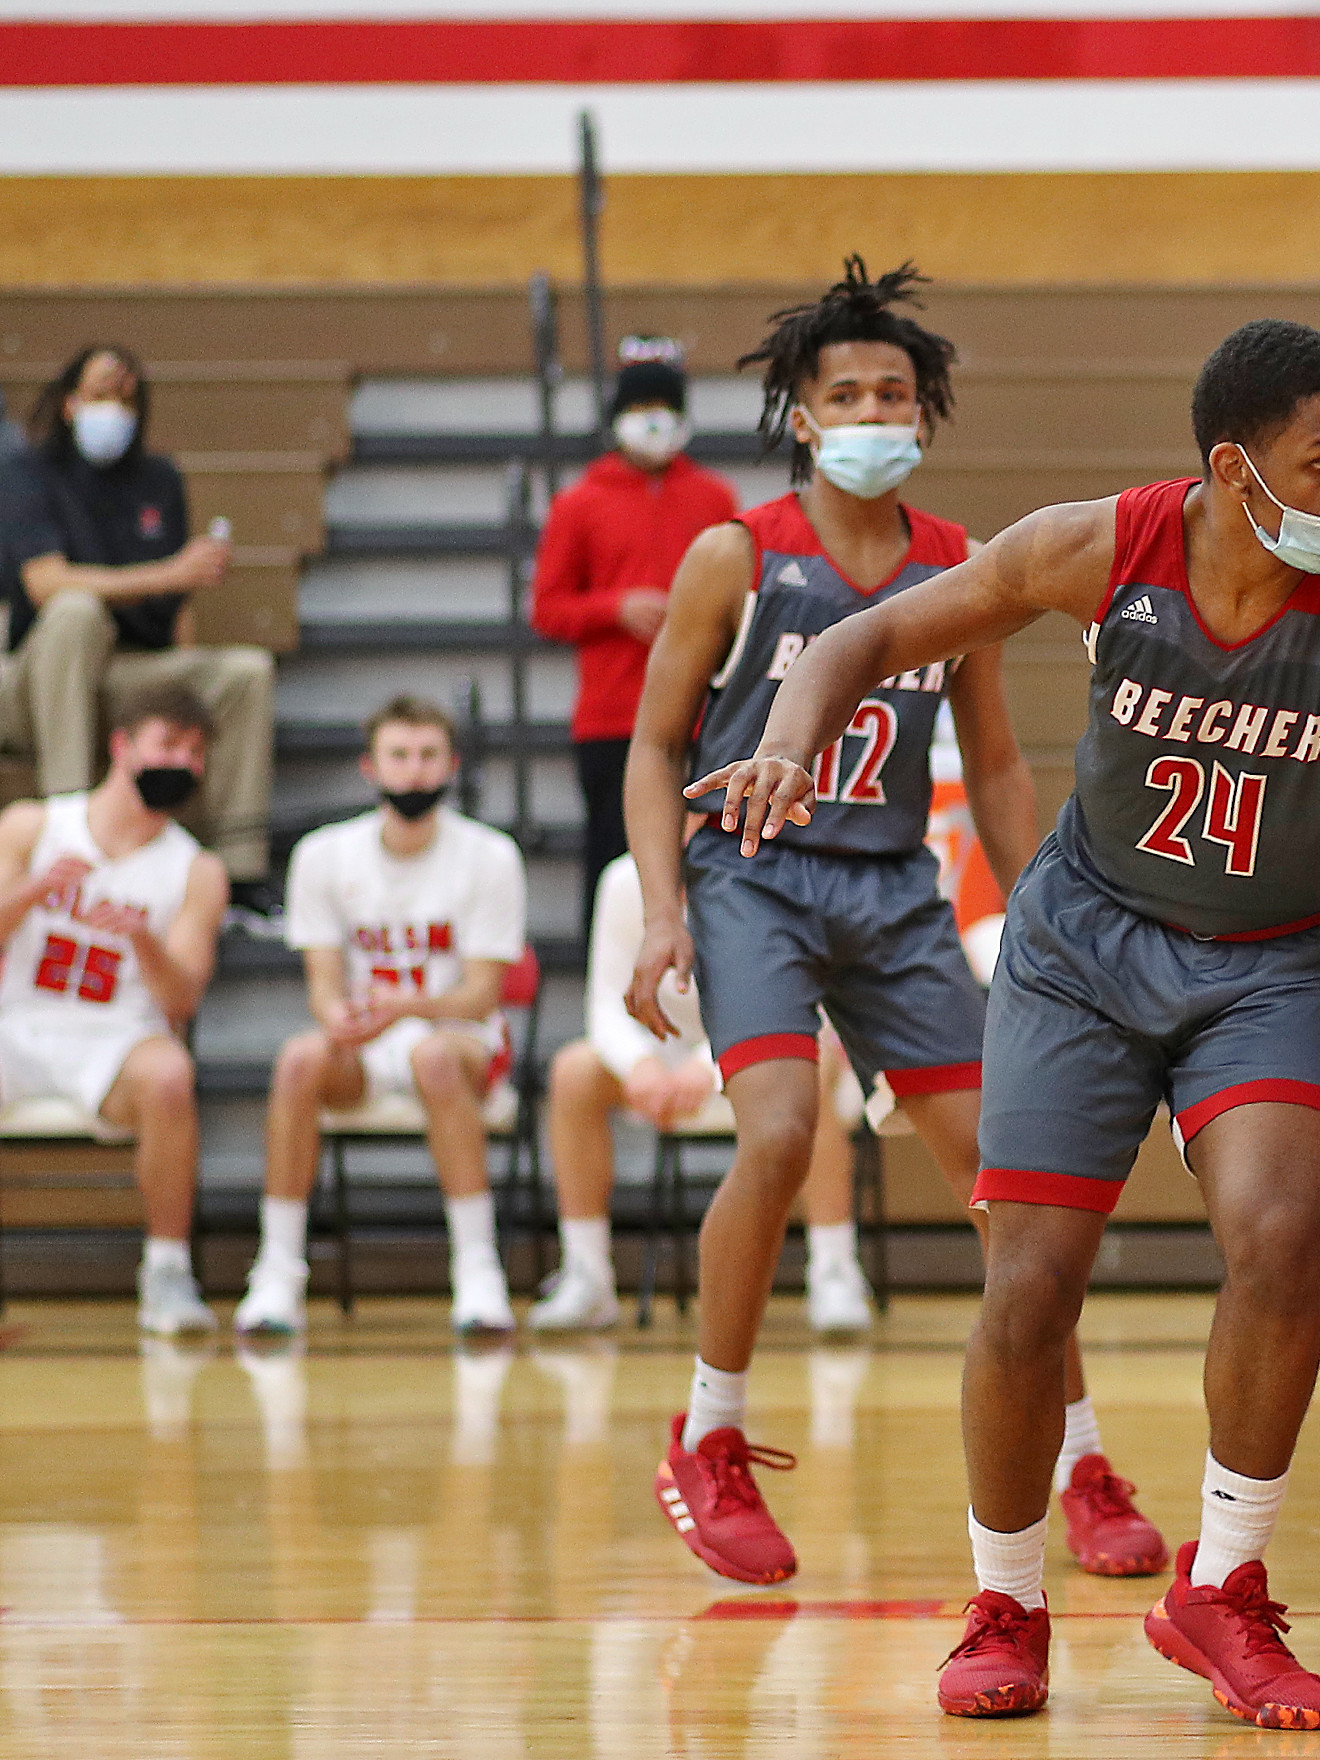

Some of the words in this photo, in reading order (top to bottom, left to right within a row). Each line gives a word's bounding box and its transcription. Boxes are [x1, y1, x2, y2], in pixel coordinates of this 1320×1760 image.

[1121, 610, 1158, 624] adidas
[1135, 756, 1268, 877] 24
[35, 934, 122, 1003] 25
